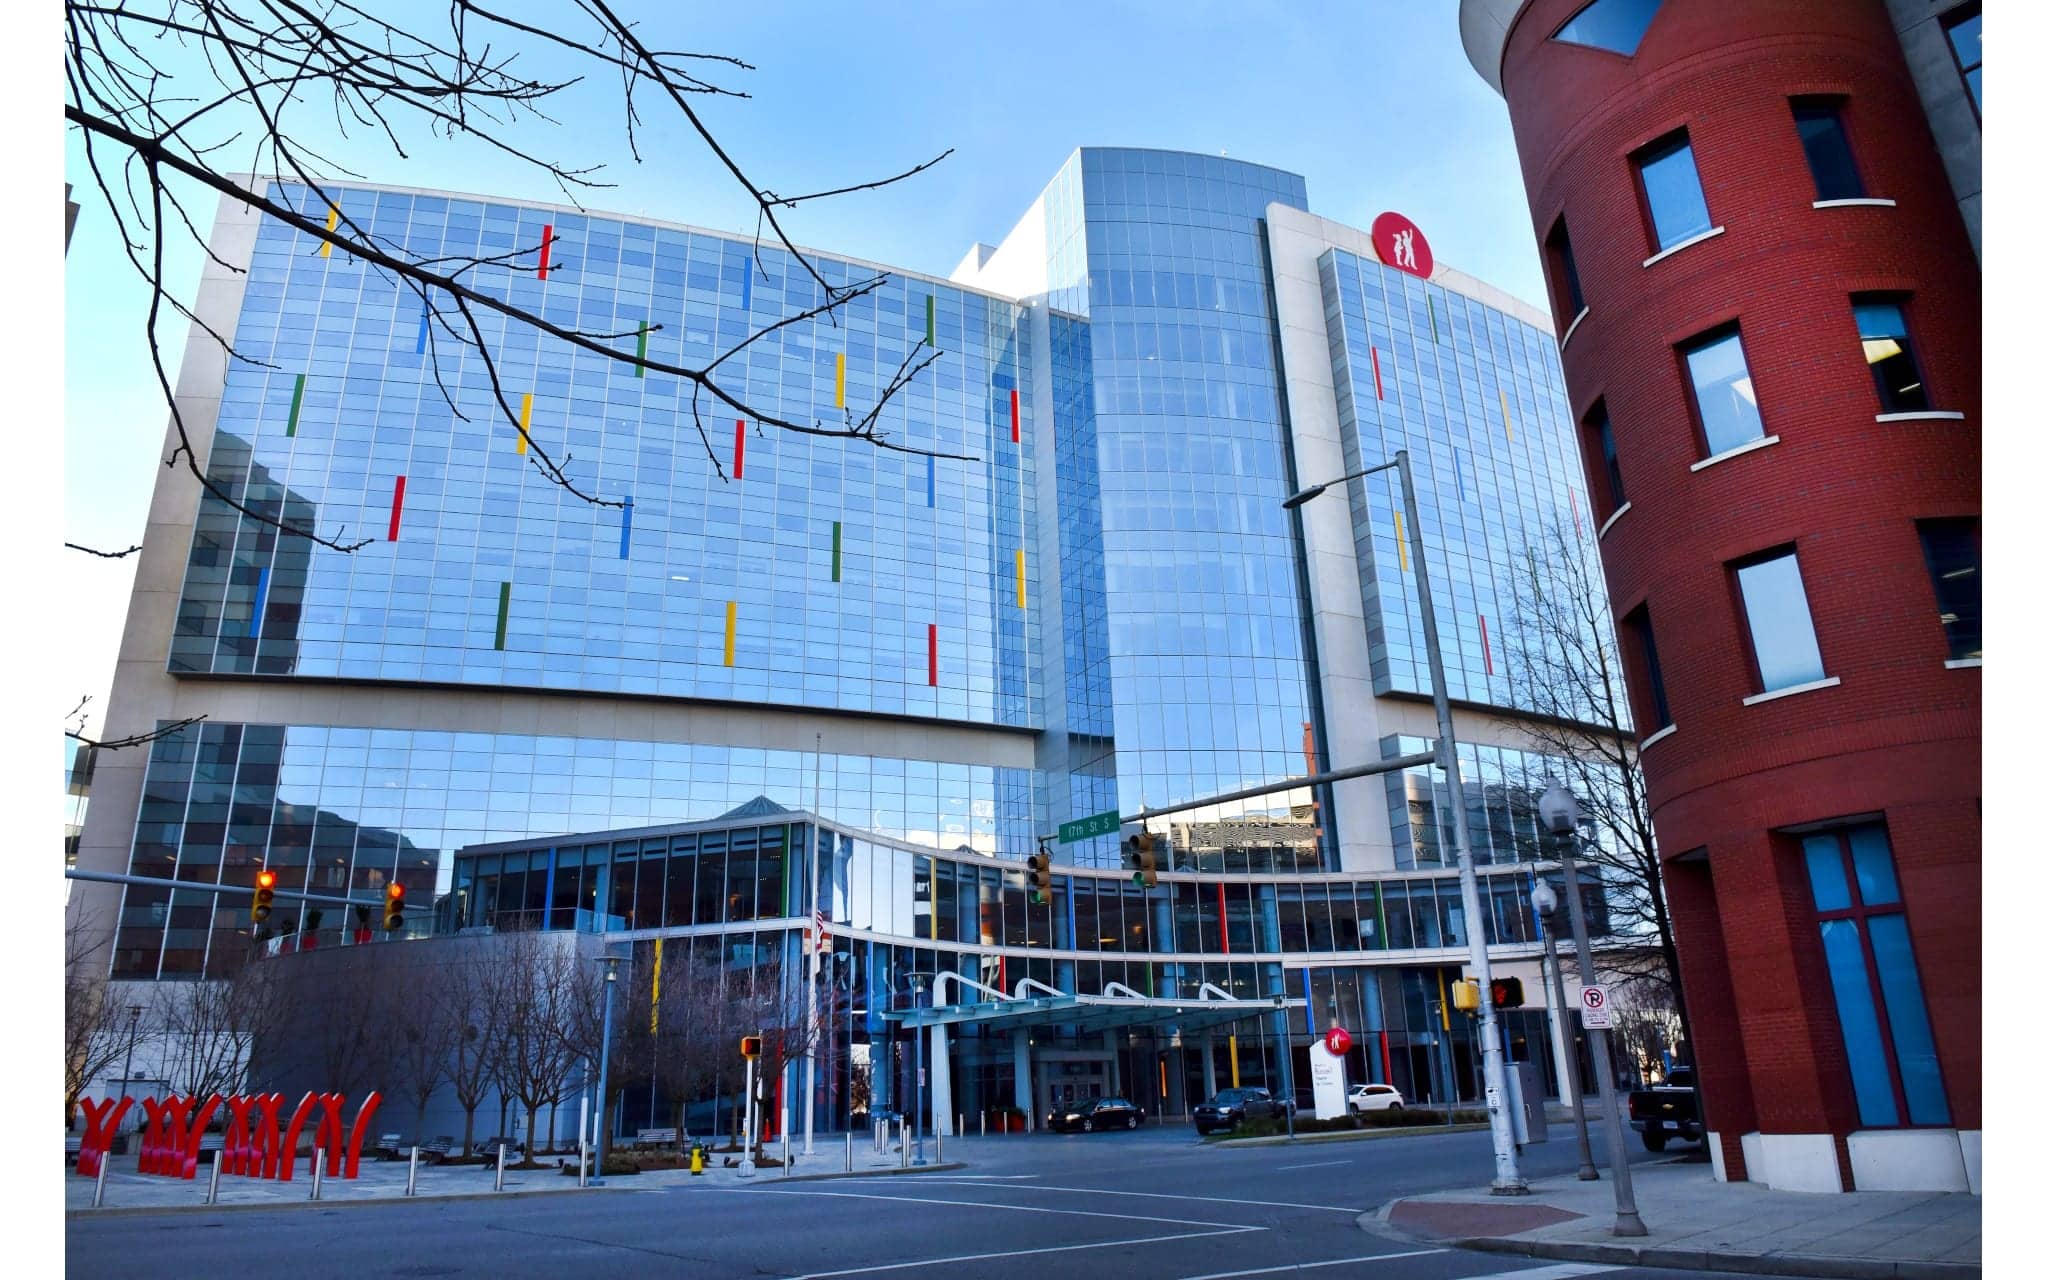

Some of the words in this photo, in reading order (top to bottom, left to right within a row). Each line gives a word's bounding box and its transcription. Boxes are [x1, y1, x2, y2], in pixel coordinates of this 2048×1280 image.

[1068, 824, 1084, 838] 17th
[1090, 821, 1098, 832] St
[1104, 817, 1109, 829] S
